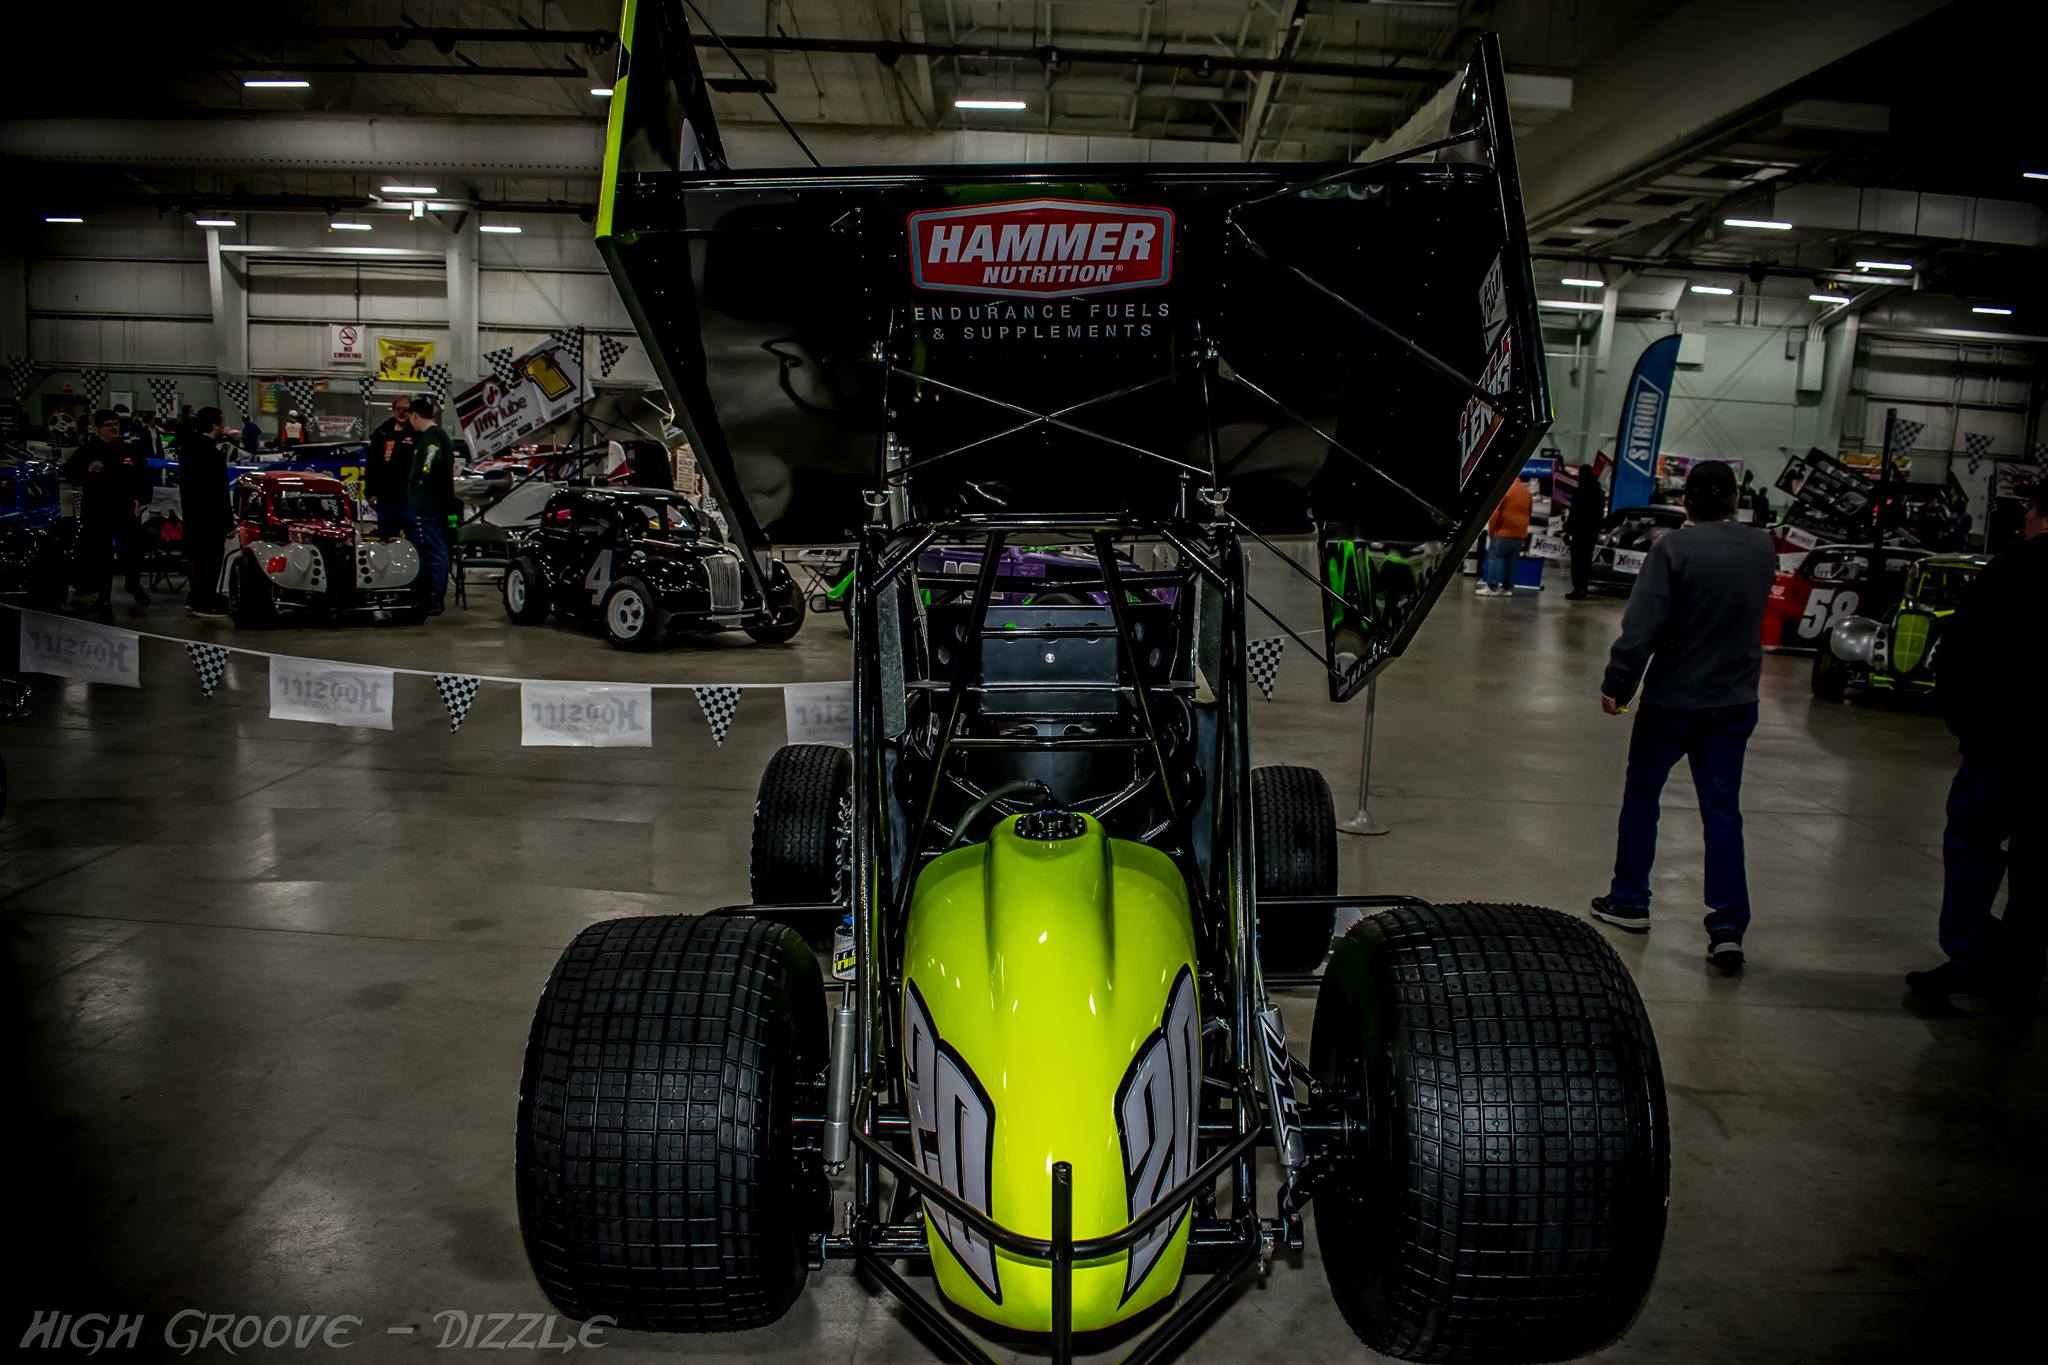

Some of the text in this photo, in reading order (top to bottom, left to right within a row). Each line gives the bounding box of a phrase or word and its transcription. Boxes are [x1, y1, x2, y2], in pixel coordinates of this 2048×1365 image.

[927, 223, 1156, 263] HAMMER
[914, 303, 1170, 321] ENDURANCE FUELS
[932, 324, 1152, 340] & SUPPLEMENTS
[1628, 390, 1660, 462] STROUD
[1616, 554, 1642, 566] Hoos
[1796, 587, 1860, 640] 58
